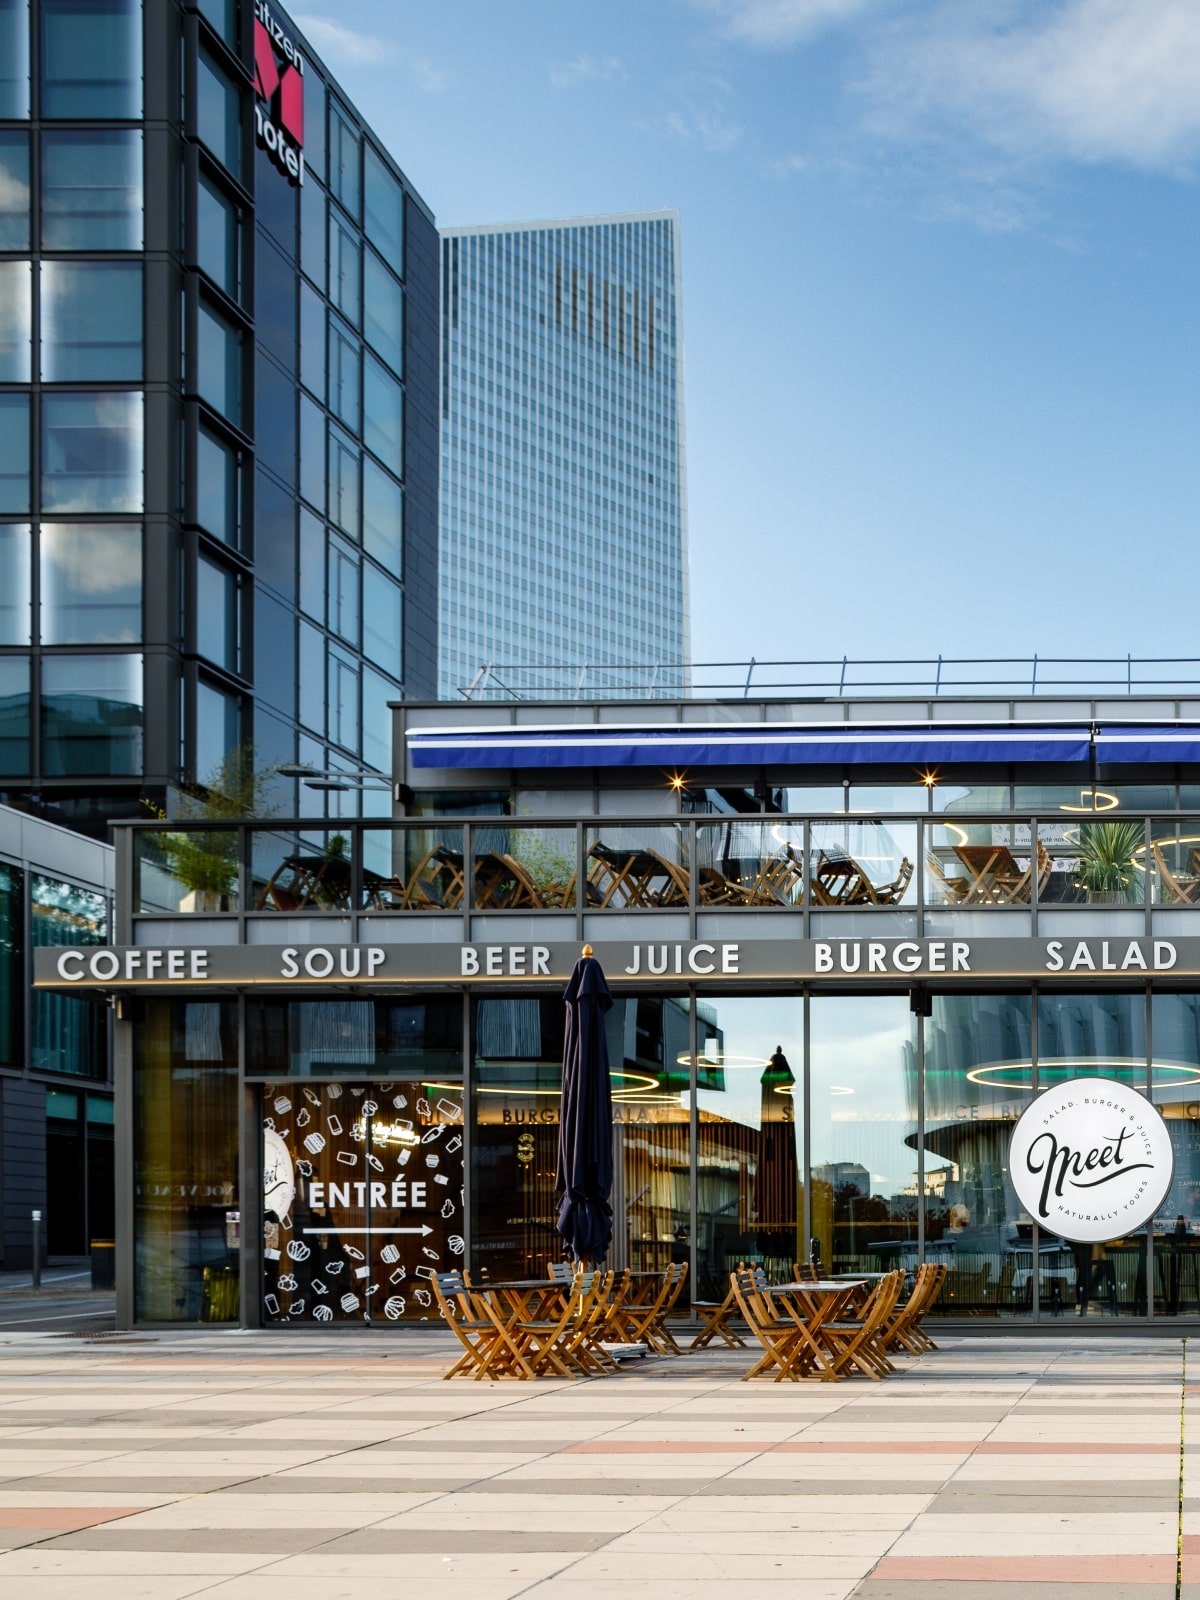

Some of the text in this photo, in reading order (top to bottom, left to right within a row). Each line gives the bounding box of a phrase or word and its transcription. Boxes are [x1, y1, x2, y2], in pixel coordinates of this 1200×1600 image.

[58, 949, 209, 981] COFFEE
[280, 946, 387, 978] SOUP
[461, 946, 551, 976] BEER
[624, 944, 740, 975] JUICE
[814, 942, 972, 973] BURGER
[1045, 941, 1178, 972] SALAD
[502, 1108, 561, 1123] BURG
[1084, 1098, 1126, 1114] BURGER
[1136, 1125, 1152, 1156] JUICE
[309, 1173, 427, 1208] ENTRÉE
[1057, 1181, 1148, 1222] NATURALLY YOURS
